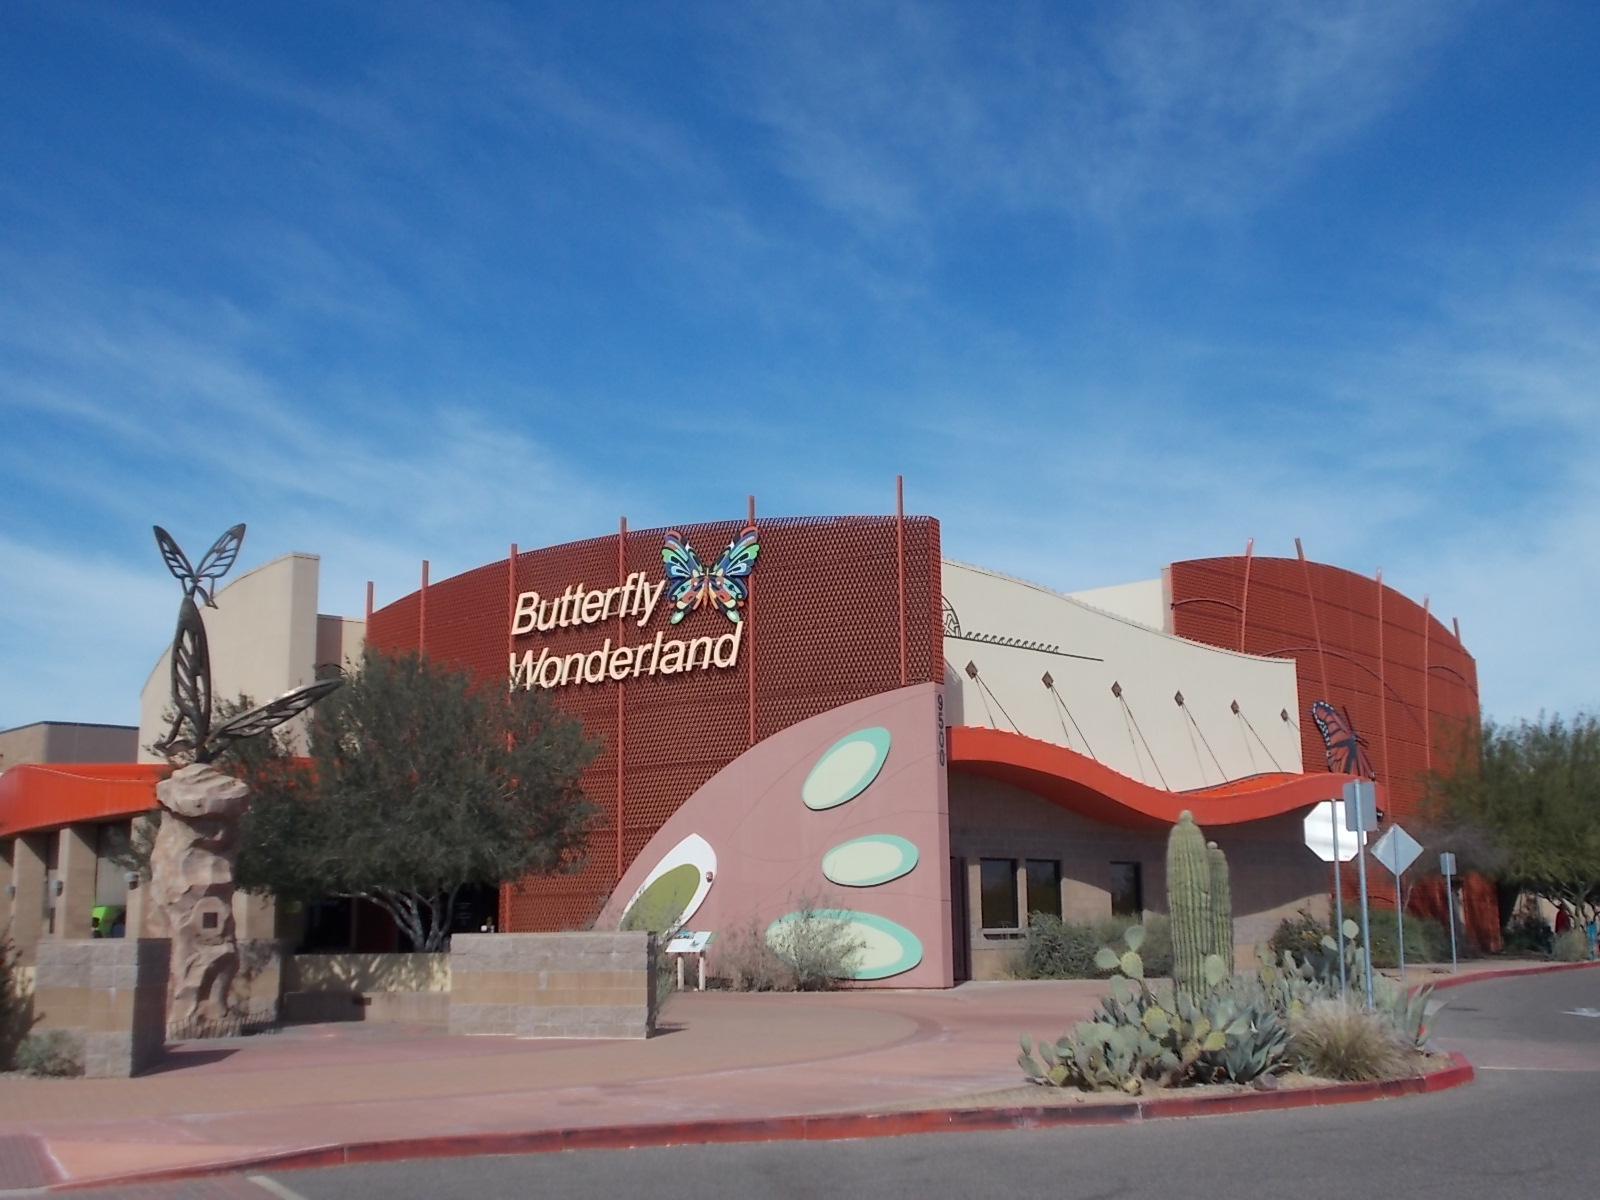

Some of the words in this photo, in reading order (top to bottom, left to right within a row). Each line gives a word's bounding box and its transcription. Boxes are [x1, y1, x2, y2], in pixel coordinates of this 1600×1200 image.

[511, 571, 666, 636] Butterfly
[509, 620, 744, 693] Wonderland
[937, 693, 946, 767] 9500
